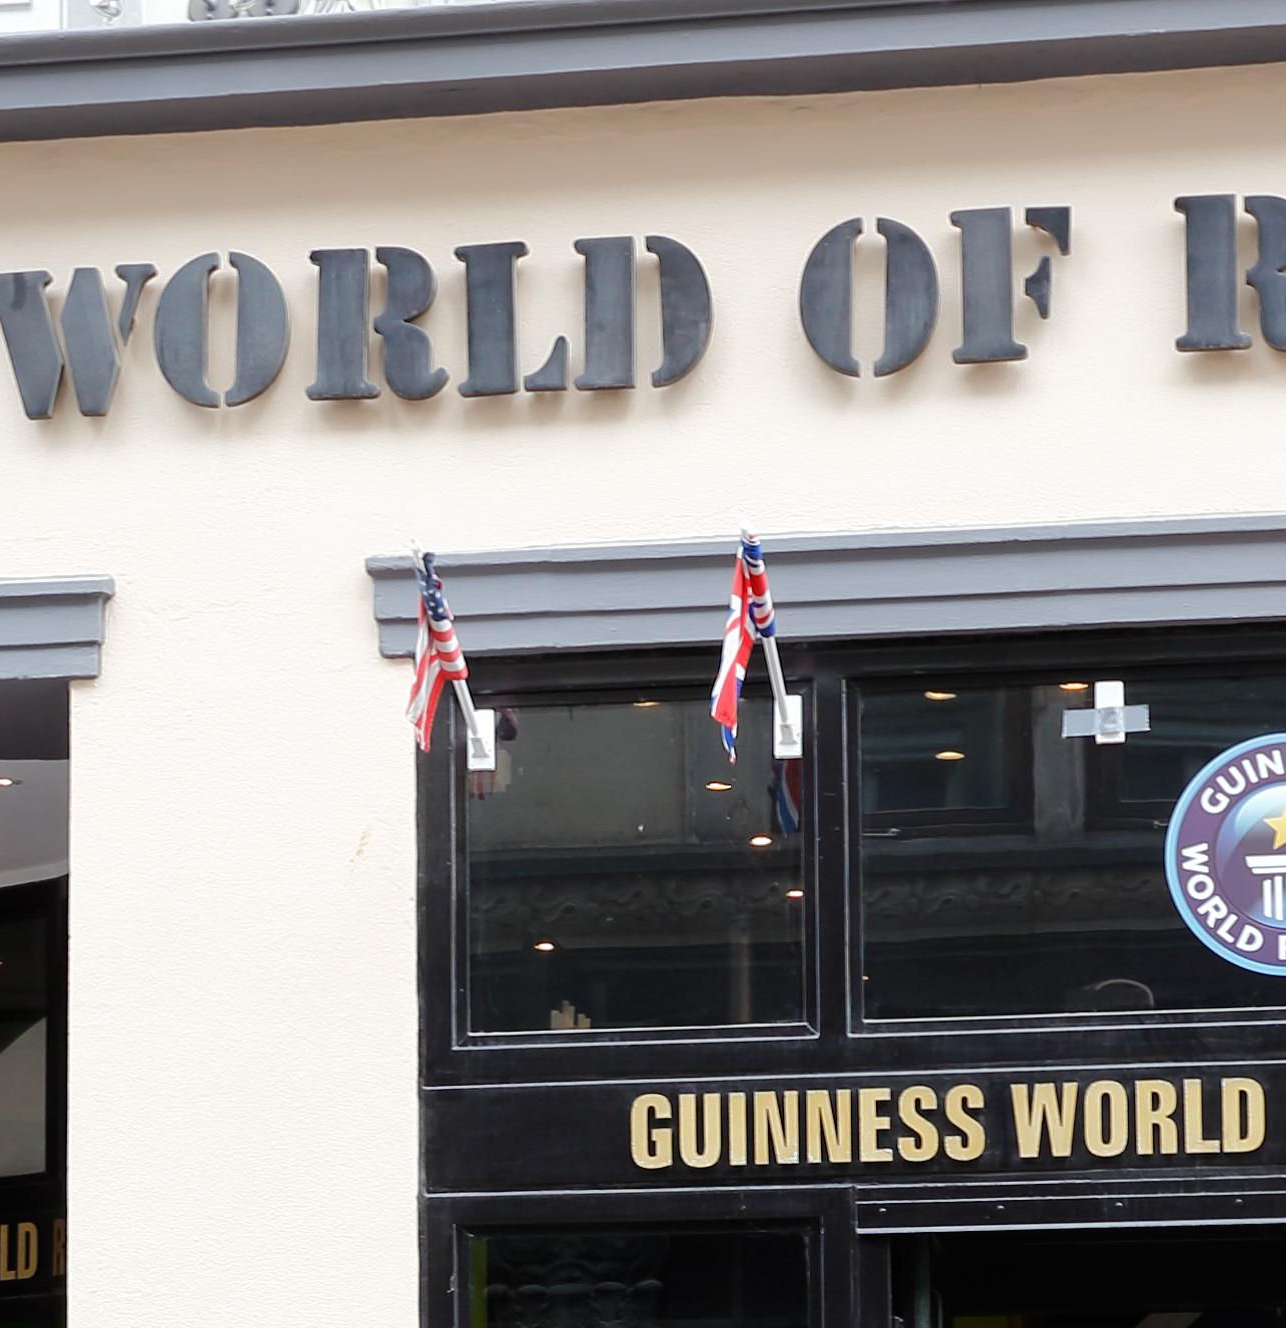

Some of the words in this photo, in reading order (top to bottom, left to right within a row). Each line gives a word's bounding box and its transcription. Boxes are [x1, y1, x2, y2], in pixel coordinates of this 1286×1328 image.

[799, 206, 1072, 377] OF
[1181, 842, 1264, 952] WORLD
[629, 1083, 986, 1169] GUINNESS
[1010, 1077, 1267, 1160] WORLD
